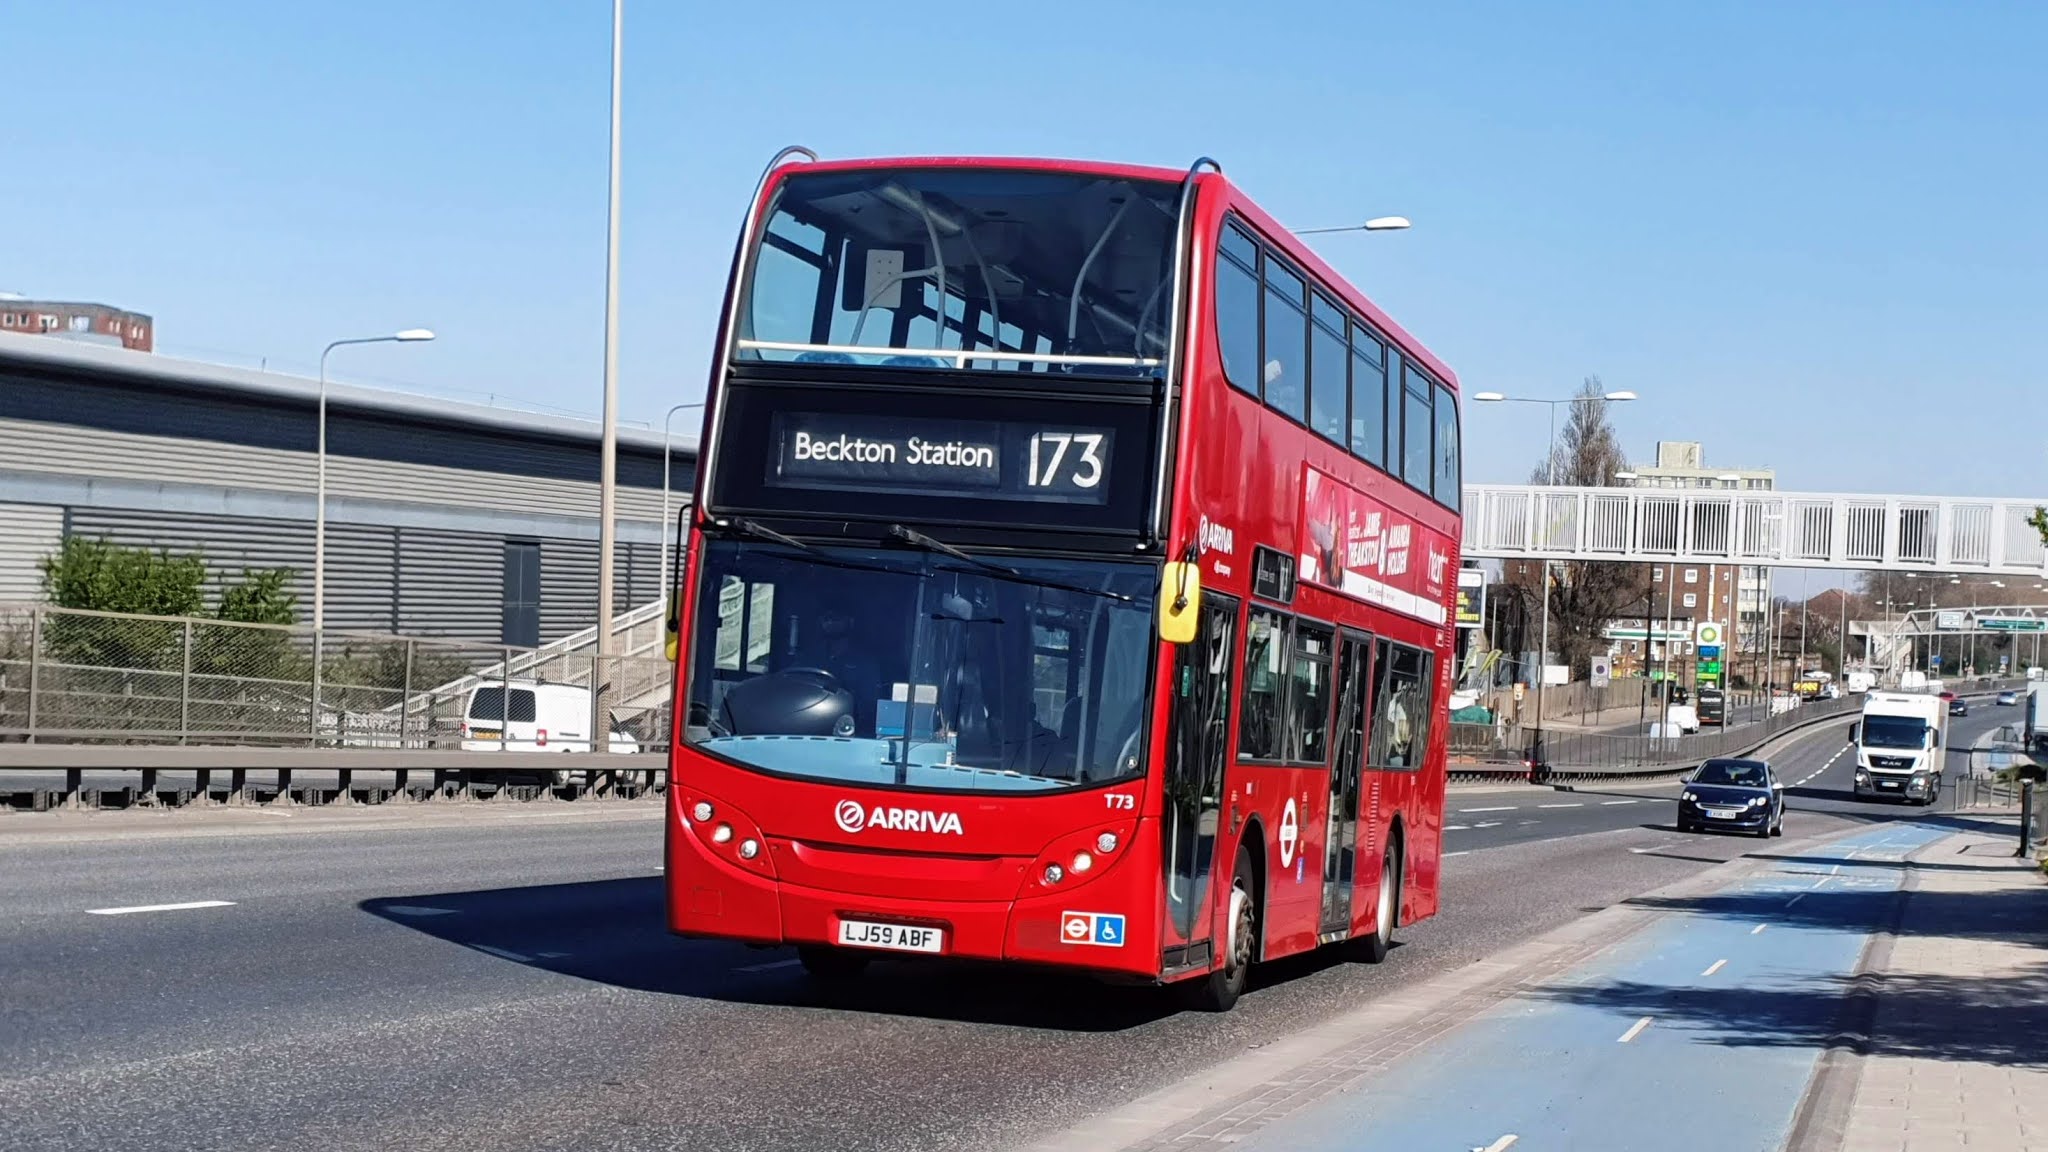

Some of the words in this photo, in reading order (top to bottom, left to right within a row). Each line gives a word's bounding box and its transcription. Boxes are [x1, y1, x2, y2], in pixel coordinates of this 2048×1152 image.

[794, 431, 896, 463] Beckton
[906, 436, 993, 468] Station
[1028, 432, 1103, 488] 173
[1207, 522, 1233, 555] ARRIVA
[1103, 793, 1135, 810] T73
[867, 806, 963, 835] ARRIVA
[846, 923, 893, 944] LJ59
[898, 928, 933, 947] ABF
